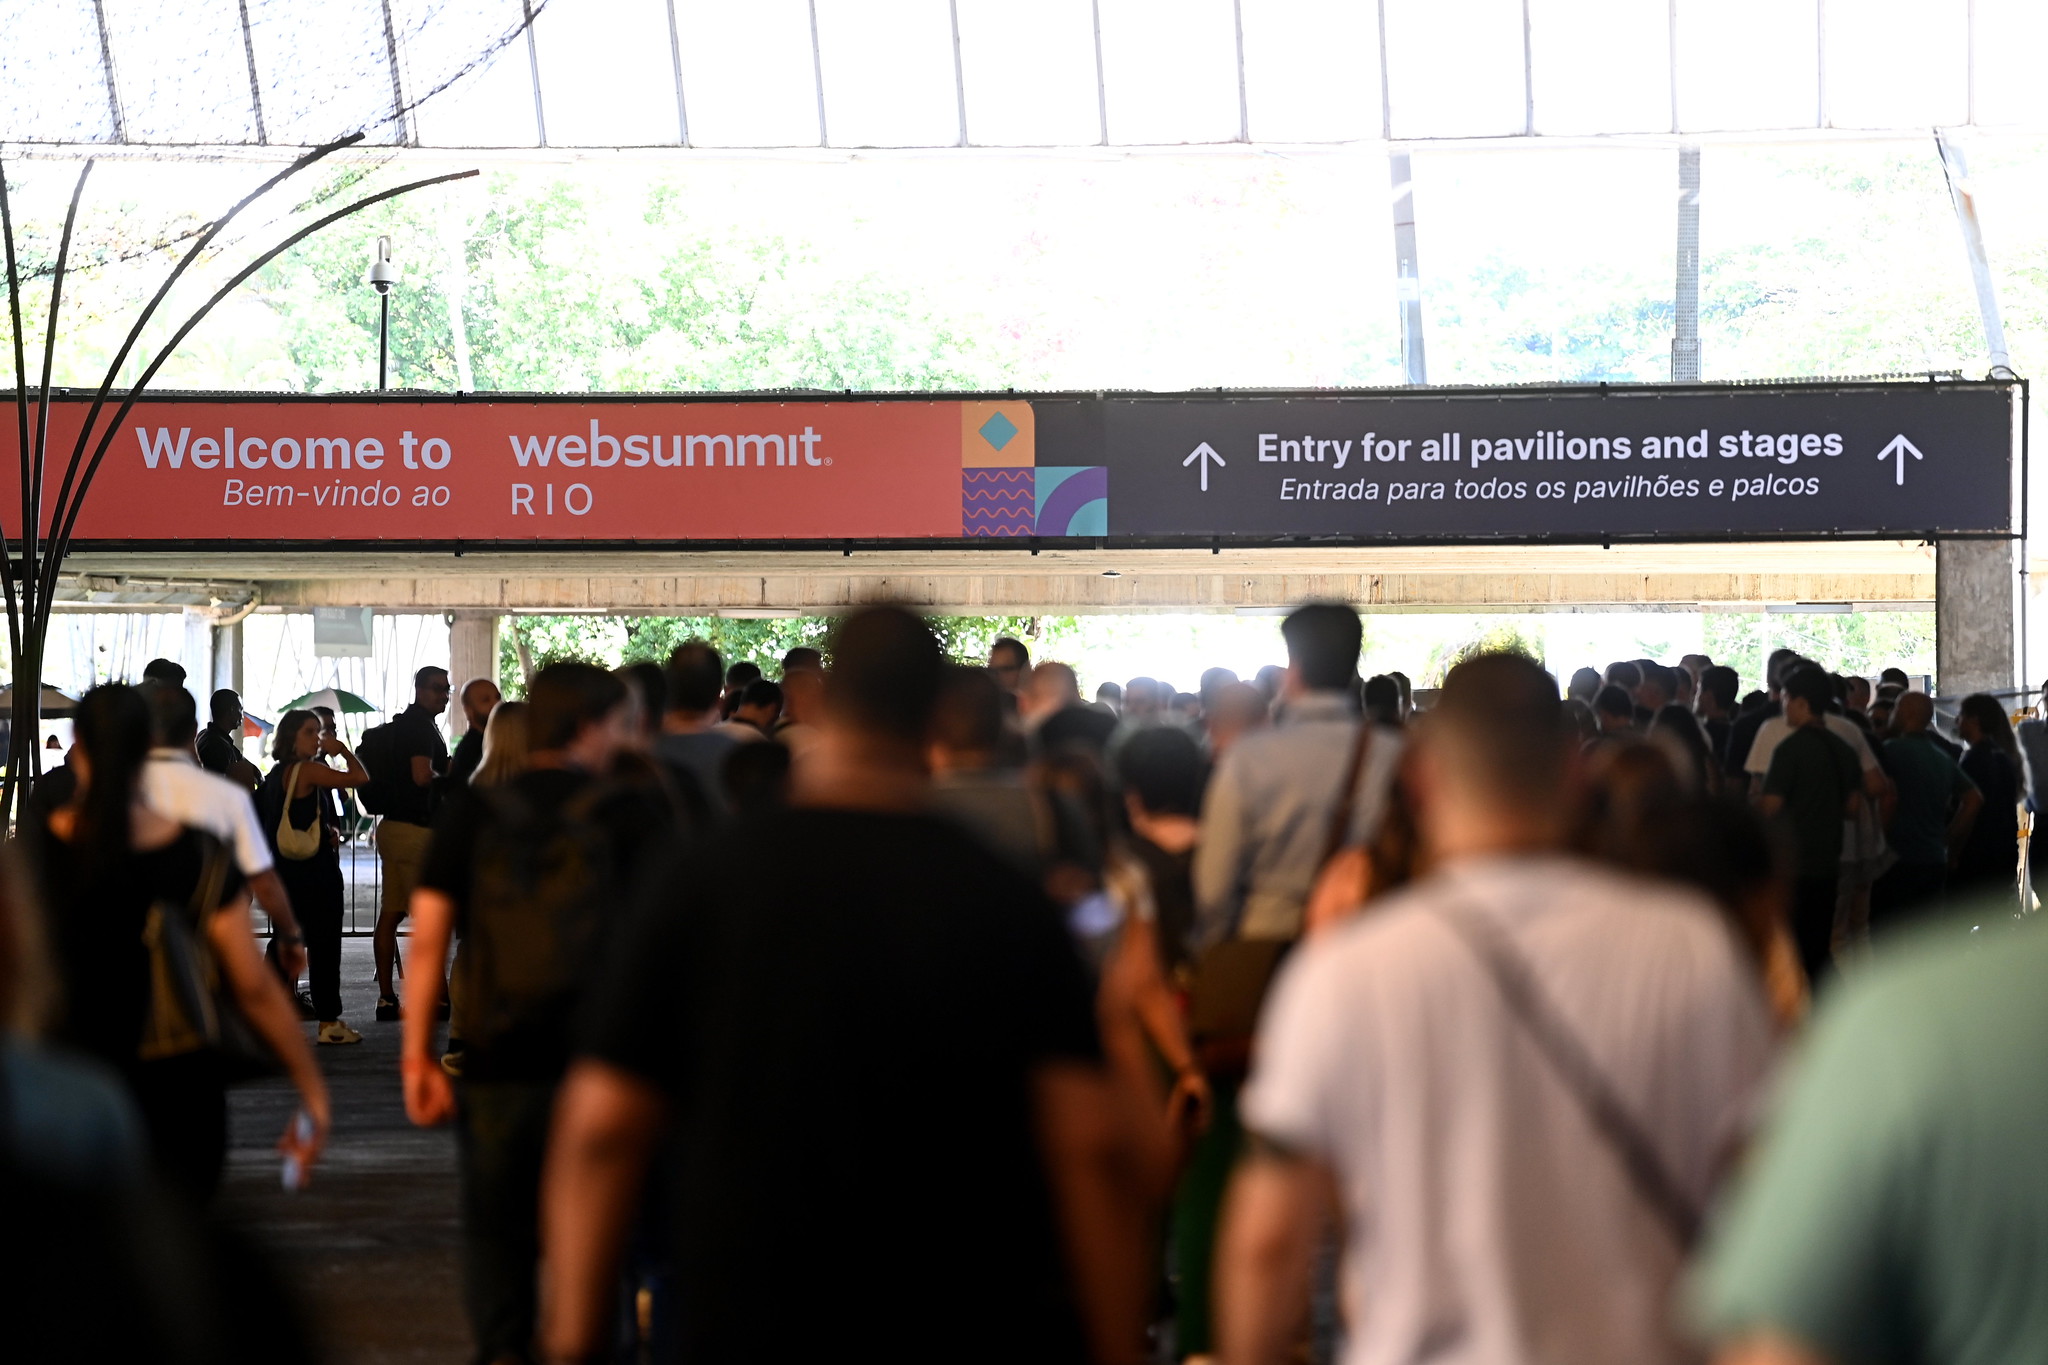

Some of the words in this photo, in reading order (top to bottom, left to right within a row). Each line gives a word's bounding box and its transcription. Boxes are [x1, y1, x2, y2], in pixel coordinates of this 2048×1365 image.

[135, 427, 385, 470] Welcome
[399, 430, 452, 470] to
[508, 418, 823, 467] websummit
[1258, 433, 1353, 470] Entry
[1361, 431, 1413, 462] for
[1420, 432, 1461, 462] all
[1470, 429, 1632, 469] pavilions
[1640, 428, 1709, 460] and
[1718, 429, 1844, 465] stages
[223, 478, 401, 507] Bem-vindo
[411, 485, 451, 507] ao
[511, 482, 594, 516] RIO
[1279, 477, 1380, 501] Entrada
[1385, 482, 1446, 506] para
[1454, 476, 1528, 500] todos
[1535, 480, 1567, 499] os
[1573, 474, 1700, 504] pavilhões
[1708, 478, 1725, 497] e
[1730, 473, 1820, 502] palcos
